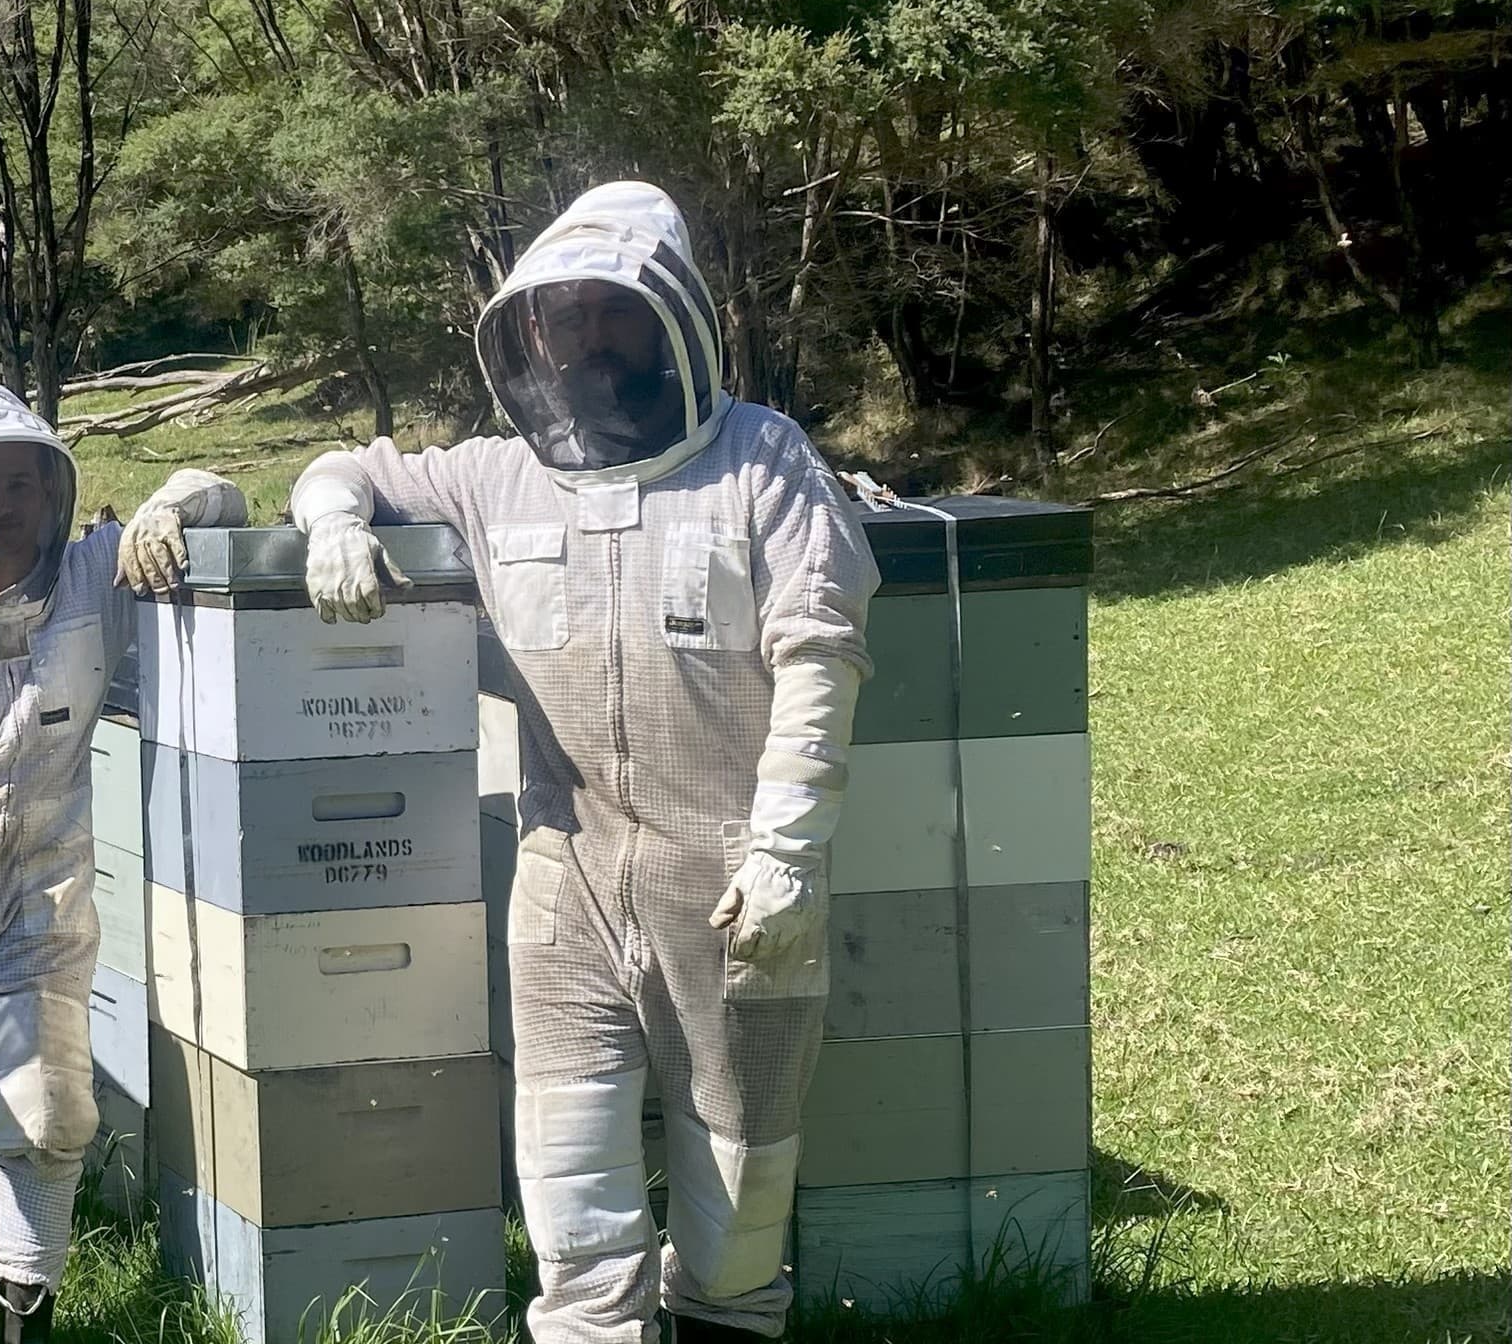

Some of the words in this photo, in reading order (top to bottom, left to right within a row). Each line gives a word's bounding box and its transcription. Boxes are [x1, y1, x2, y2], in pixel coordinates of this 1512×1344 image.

[301, 696, 413, 717] WOODLAND
[298, 838, 413, 863] WOODLANDS
[325, 863, 388, 884] D6779
